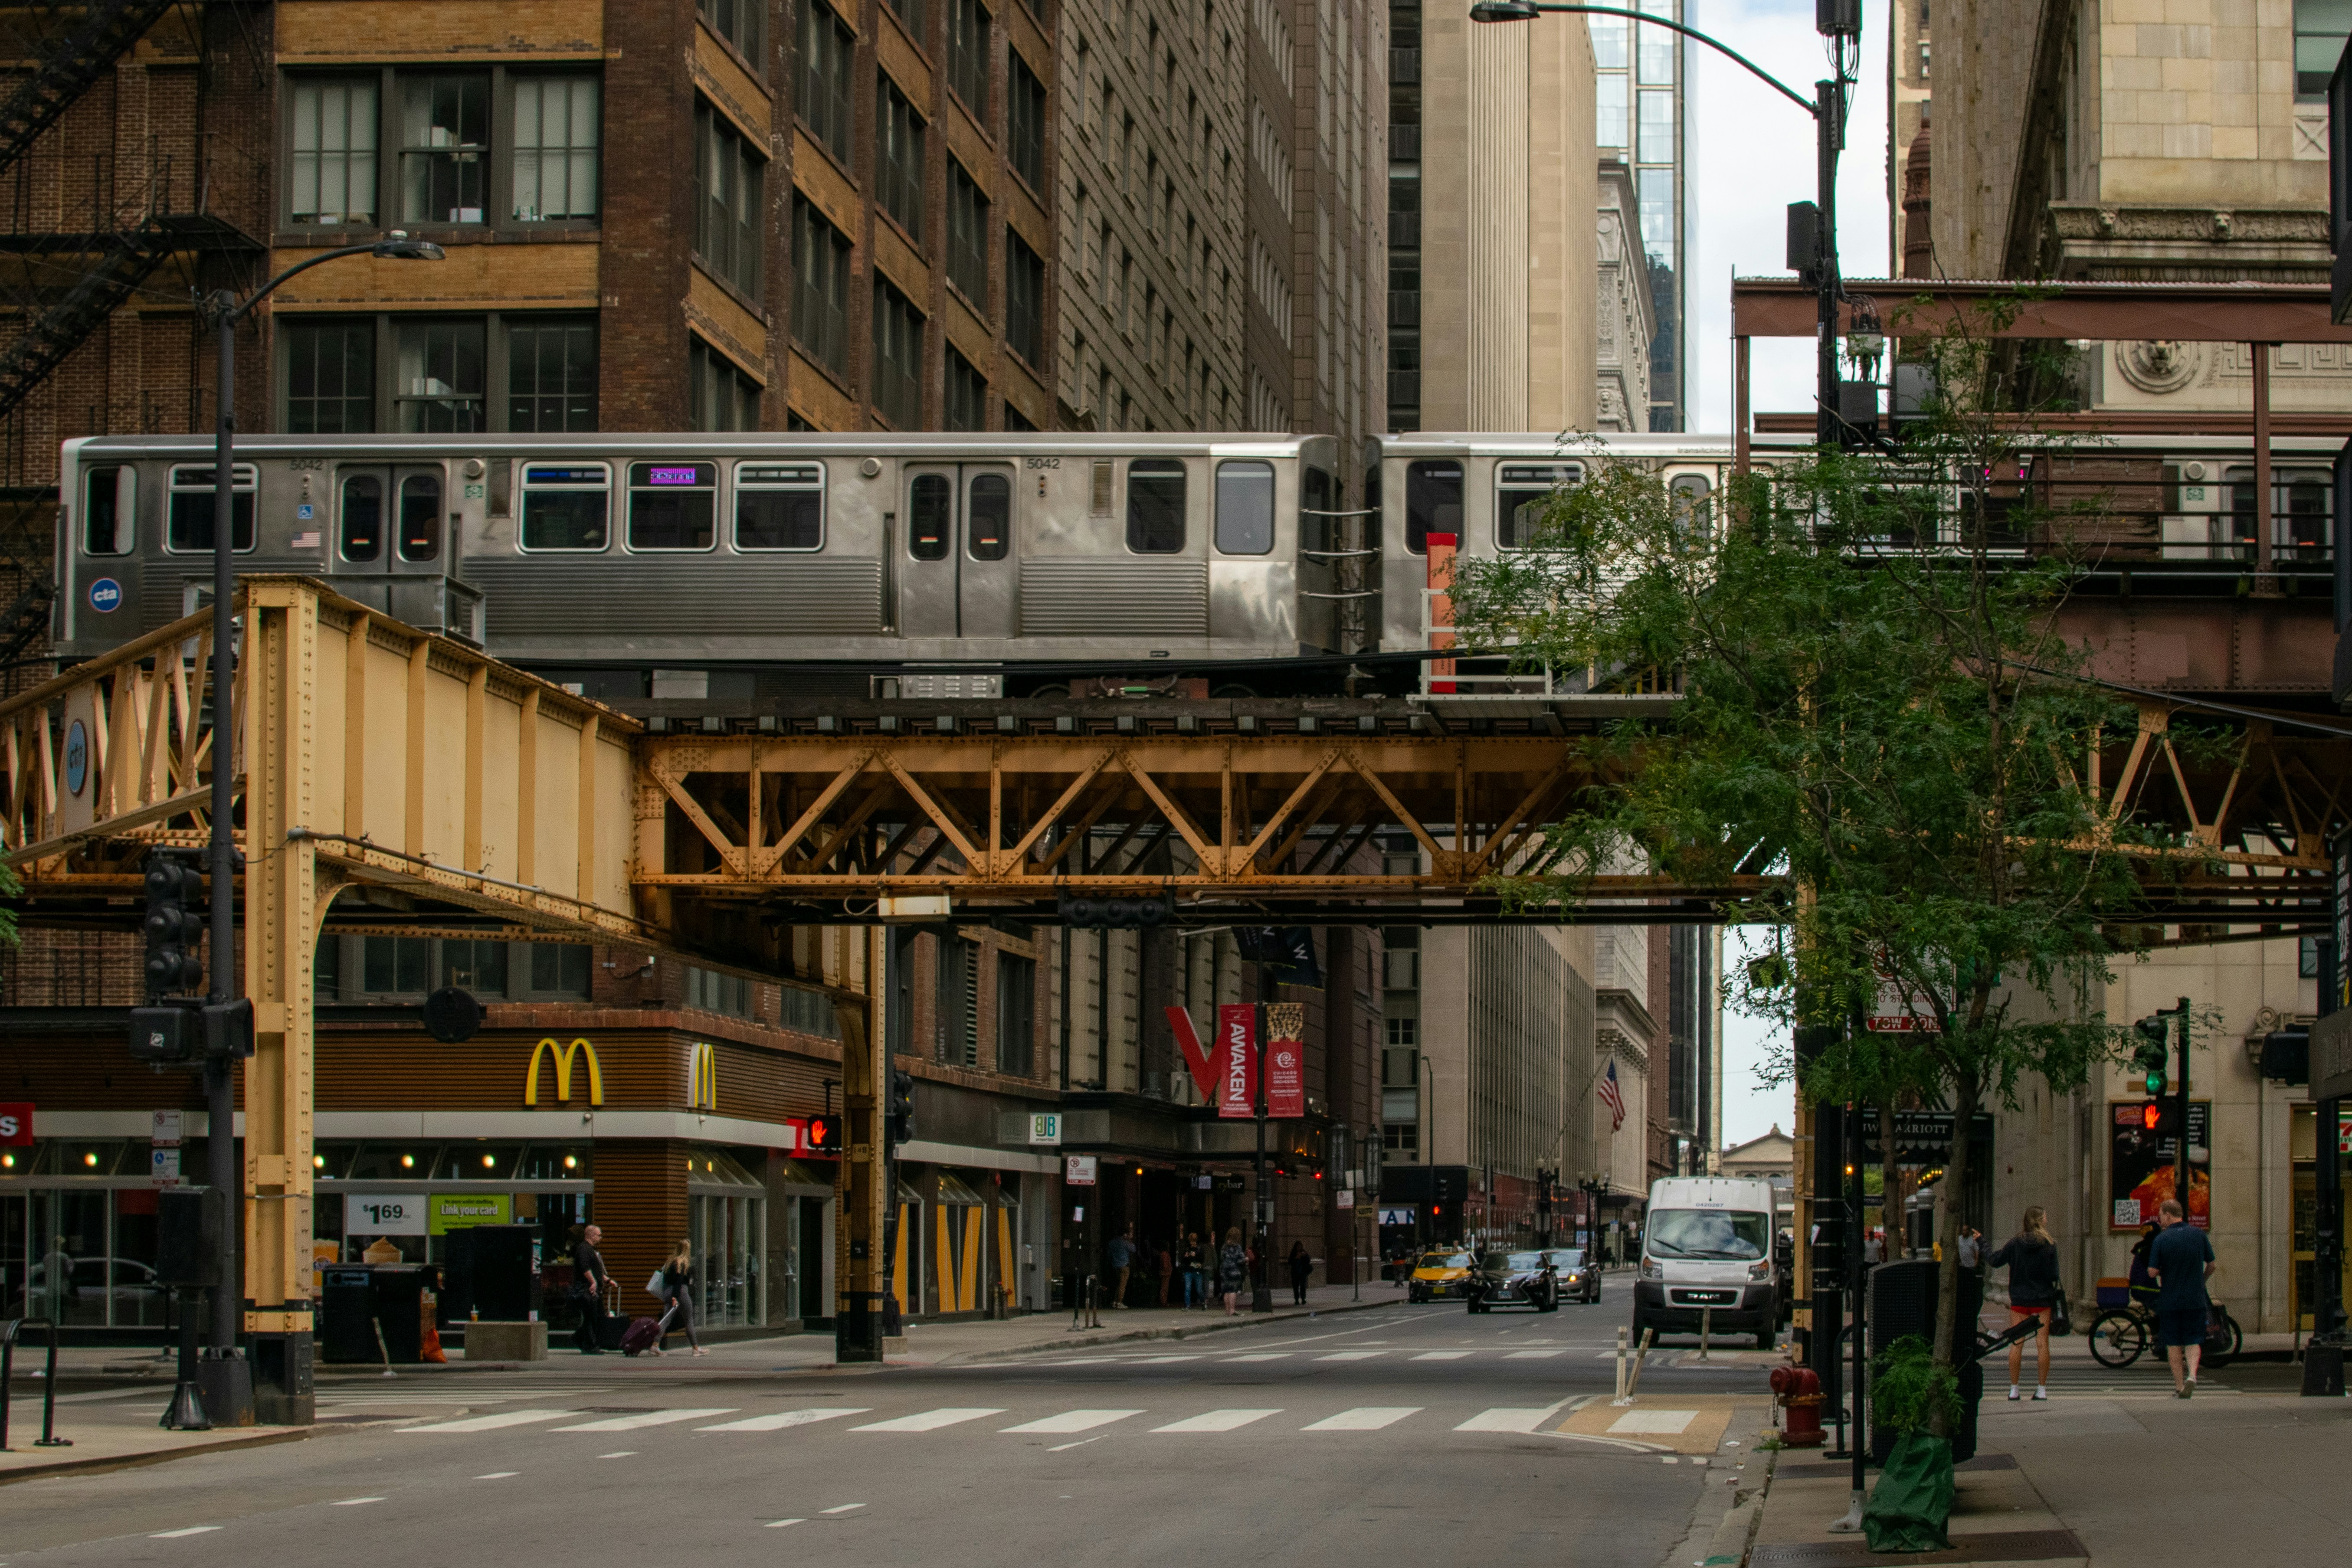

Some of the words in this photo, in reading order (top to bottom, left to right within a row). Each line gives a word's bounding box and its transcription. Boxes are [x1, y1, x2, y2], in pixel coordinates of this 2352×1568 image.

[290, 458, 322, 471] 5042
[1027, 458, 1059, 469] 5042
[93, 588, 118, 602] cta
[70, 743, 83, 769] cta
[1874, 1018, 1902, 1029] TOW
[1909, 1018, 1940, 1029] ZON
[1230, 1023, 1245, 1101] AWAKEN
[1895, 1124, 1947, 1134] ARRIOTT
[441, 1205, 458, 1215] Link
[459, 1207, 478, 1218] your
[479, 1205, 498, 1215] card
